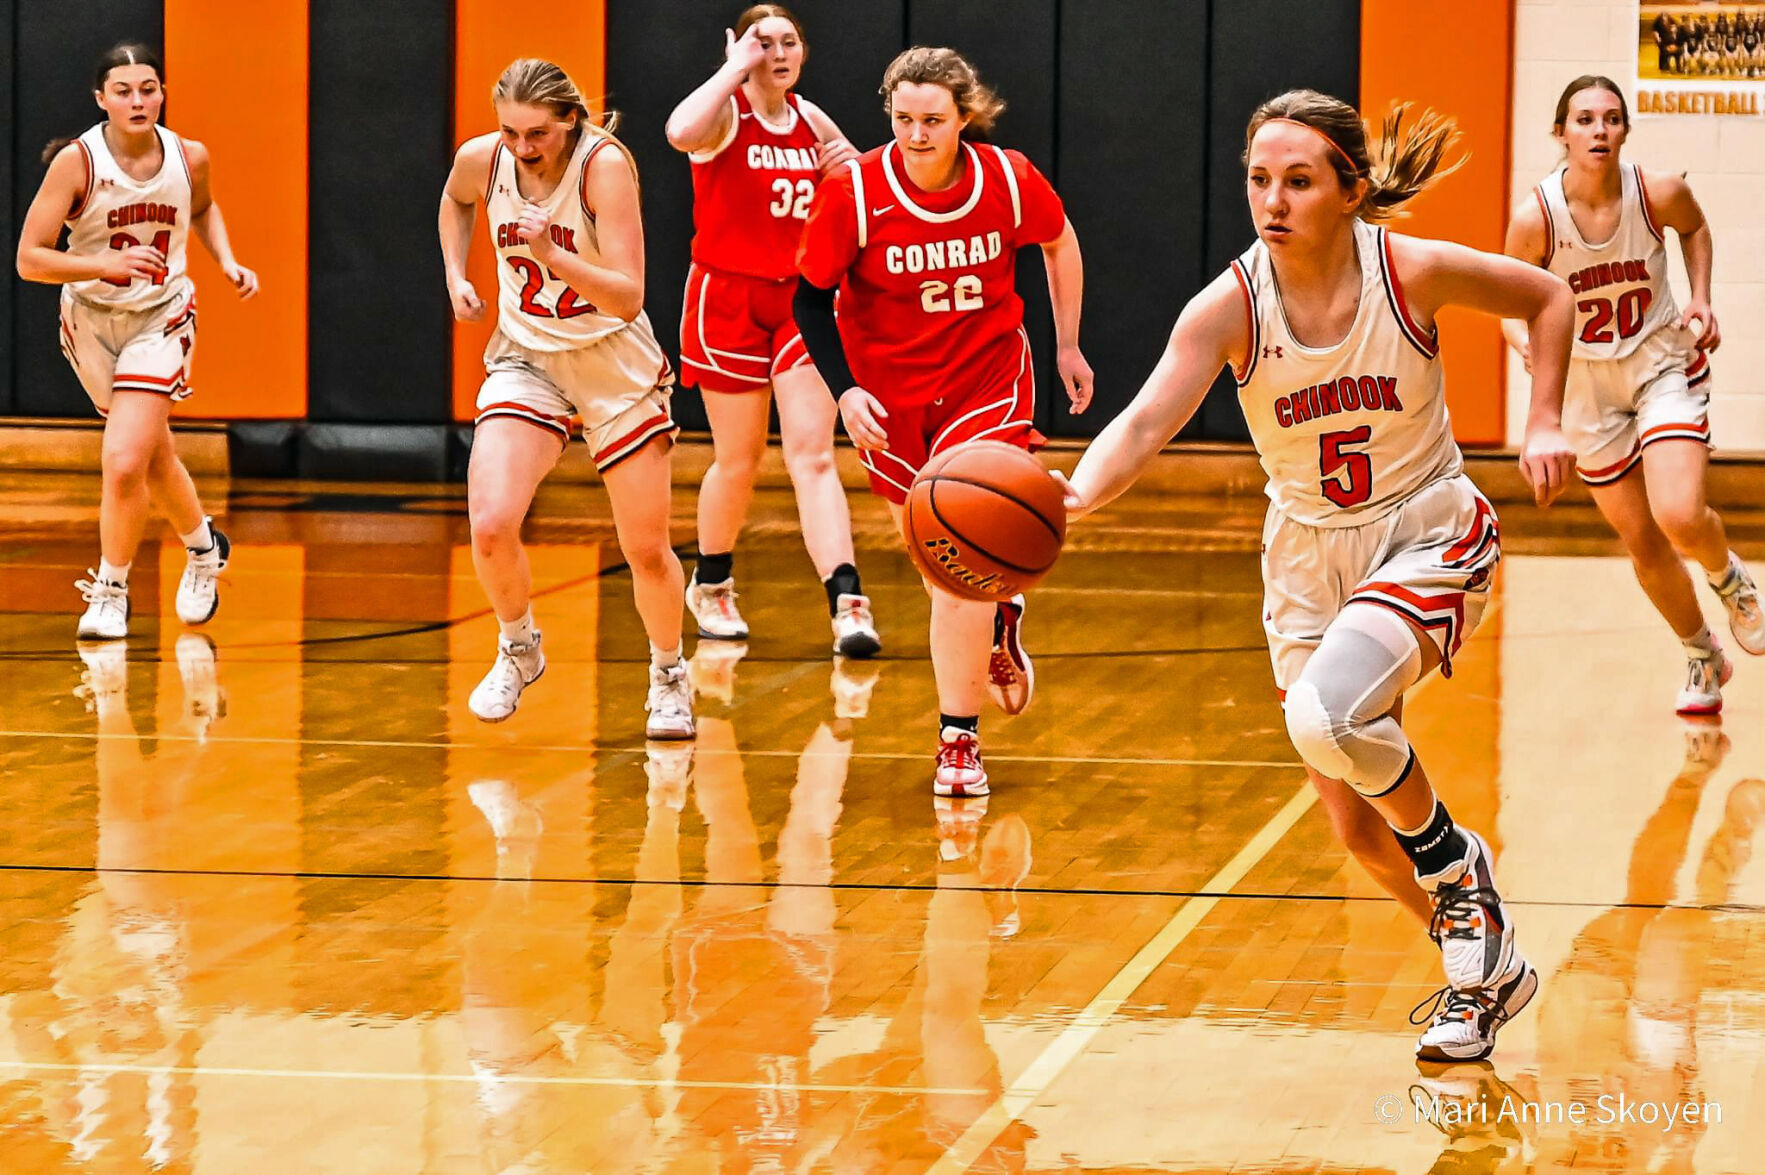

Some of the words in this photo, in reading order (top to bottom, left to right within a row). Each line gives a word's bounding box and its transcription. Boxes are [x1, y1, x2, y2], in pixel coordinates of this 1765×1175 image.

[1637, 90, 1759, 115] BASKETBALL
[748, 144, 820, 172] CONRA
[107, 202, 178, 230] CHINOOK
[770, 177, 815, 220] 32
[497, 222, 579, 255] CHOK
[886, 230, 1002, 275] CONRAD
[919, 274, 984, 313] 22
[1568, 258, 1651, 295] CHINOOK
[1577, 287, 1653, 344] 20
[1274, 374, 1404, 429] CHINOOK
[1319, 425, 1373, 509] 5
